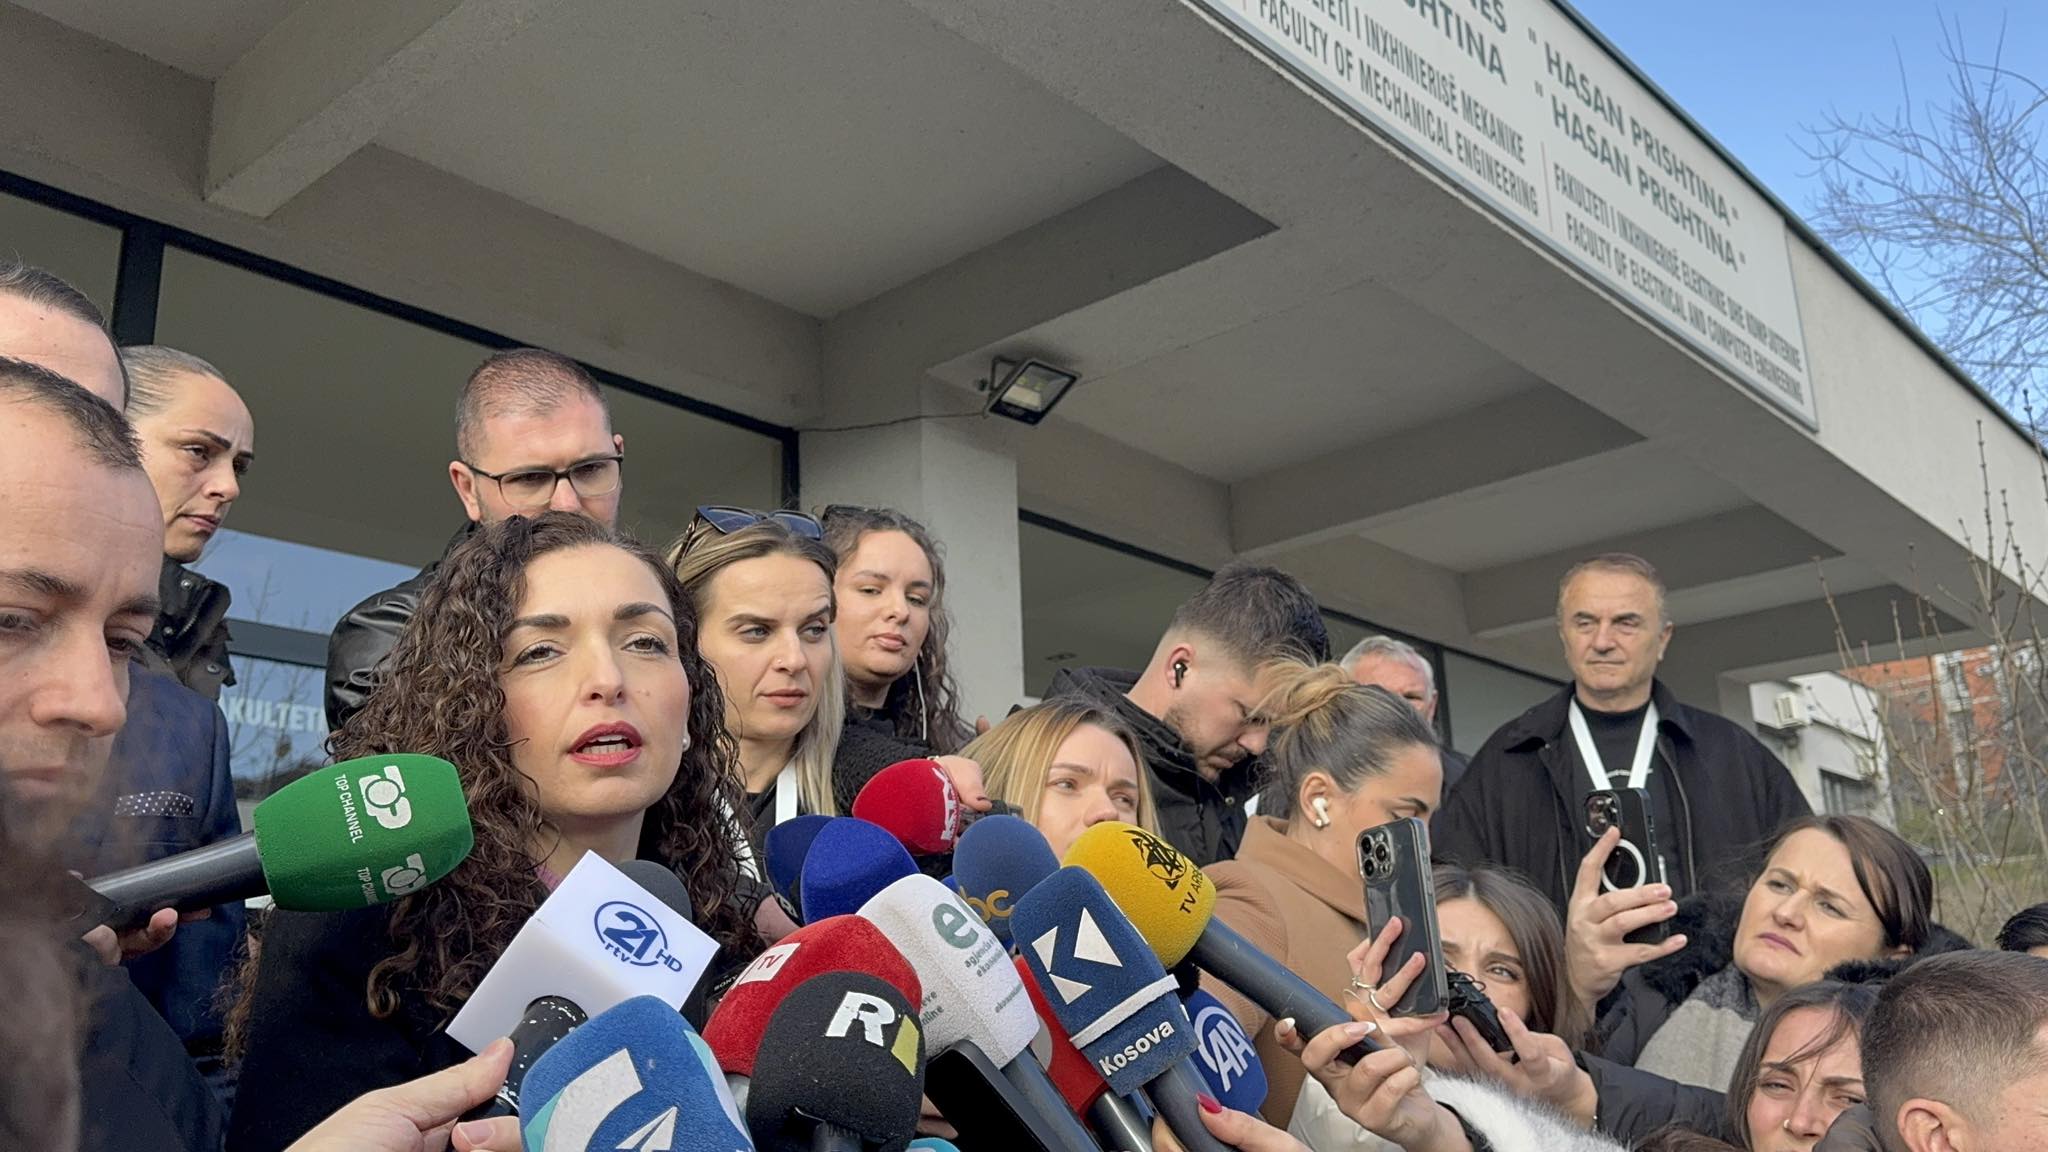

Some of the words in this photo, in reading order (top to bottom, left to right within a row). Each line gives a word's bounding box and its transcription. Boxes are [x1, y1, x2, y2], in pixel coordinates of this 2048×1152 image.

[1334, 40, 1354, 82] OF
[1359, 58, 1453, 155] MECHANICAL
[1456, 130, 1539, 217] ENGINEERING
[1461, 89, 1526, 166] MEKANIKE
[1554, 162, 1610, 230] FAKULTETI
[1566, 211, 1612, 270] FACULTY
[1614, 247, 1627, 280] OF
[1630, 259, 1688, 322] ELECTRICAL
[1687, 301, 1707, 336] AND
[1707, 315, 1755, 371] COMPUTER
[334, 773, 350, 791] TOP
[339, 791, 364, 844] CHANNEL
[1179, 891, 1197, 914] TV
[602, 911, 660, 961] 21
[655, 948, 683, 973] HD
[604, 942, 631, 963] rtv
[1098, 1020, 1176, 1077] Kosova
